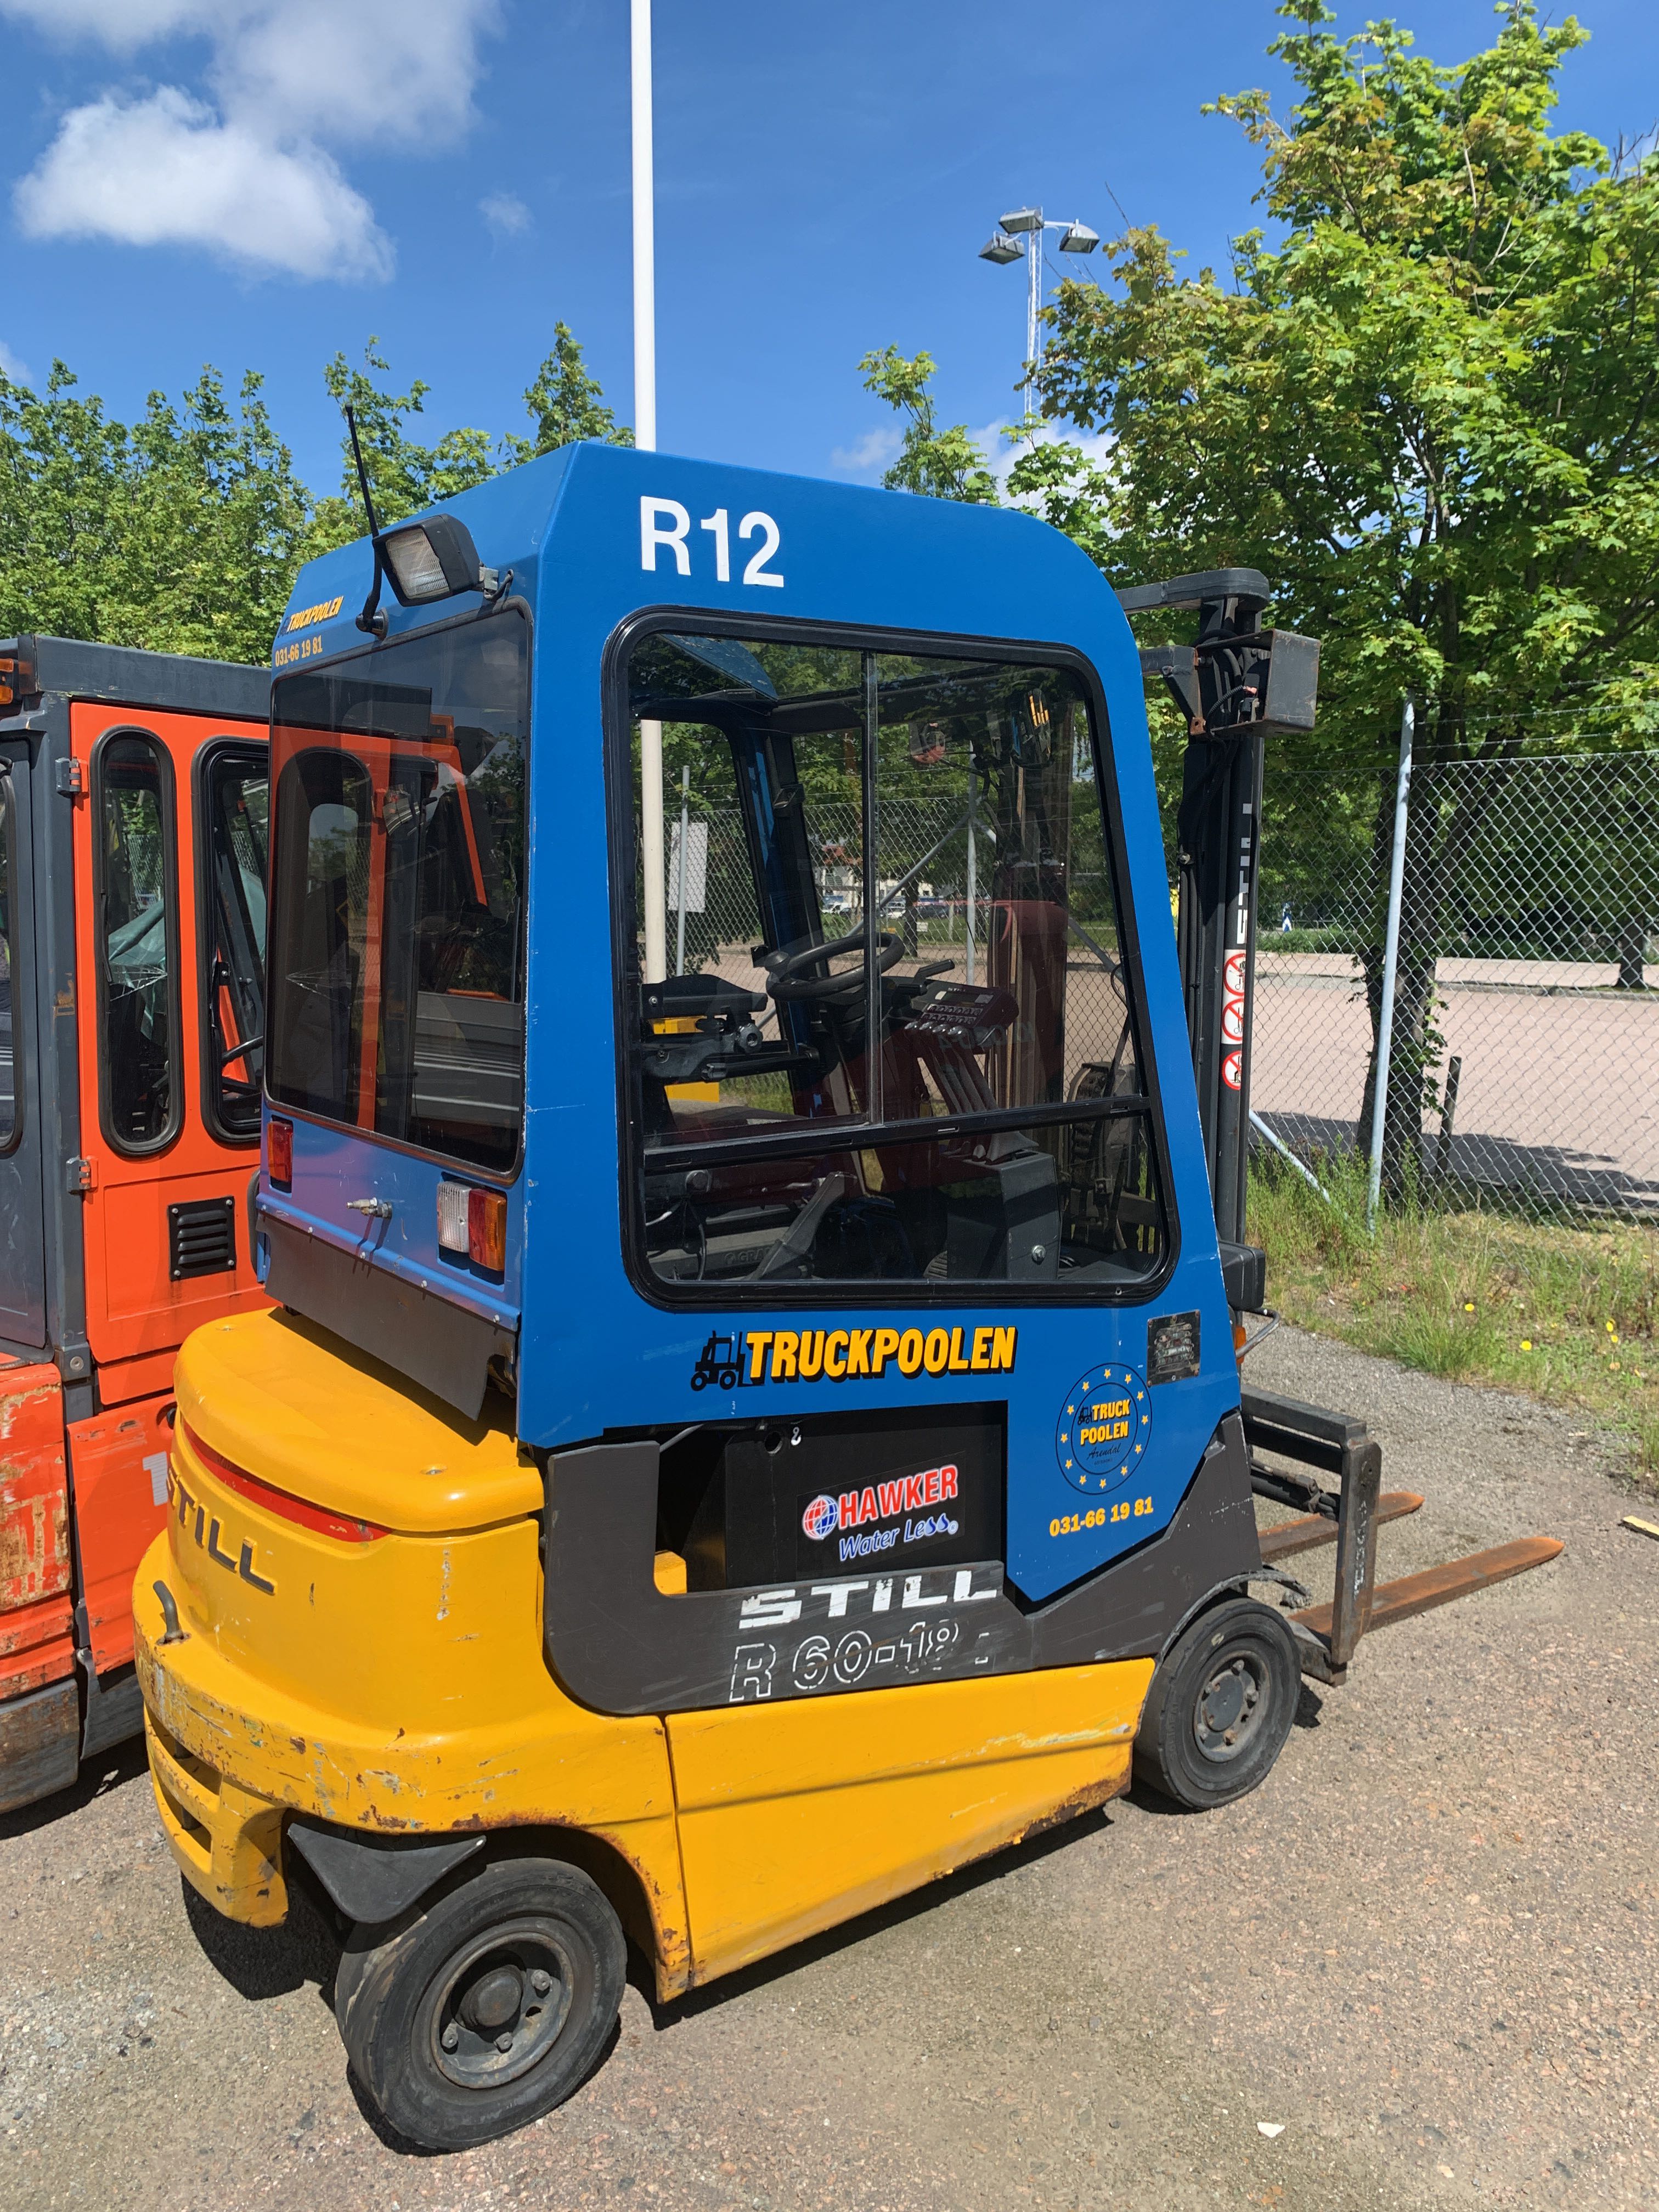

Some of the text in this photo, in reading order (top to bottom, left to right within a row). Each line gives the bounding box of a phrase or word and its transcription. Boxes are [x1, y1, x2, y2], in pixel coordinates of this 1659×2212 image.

[640, 495, 785, 588] R12
[286, 595, 345, 633] TRUCKPOOLEN
[275, 635, 323, 667] 031-66 19 81
[747, 1327, 1018, 1383] TRUCKPOOLEN
[1092, 1399, 1131, 1421] TRUCK
[1080, 1420, 1129, 1446] POOLEN
[1086, 1443, 1121, 1460] Arendal
[838, 1464, 958, 1530] HAWKER
[1049, 1496, 1154, 1537] 031-66 19 81
[166, 1454, 276, 1596] STILL
[839, 1528, 900, 1561] Water
[739, 1571, 997, 1629] STILL
[729, 1643, 776, 1702] R
